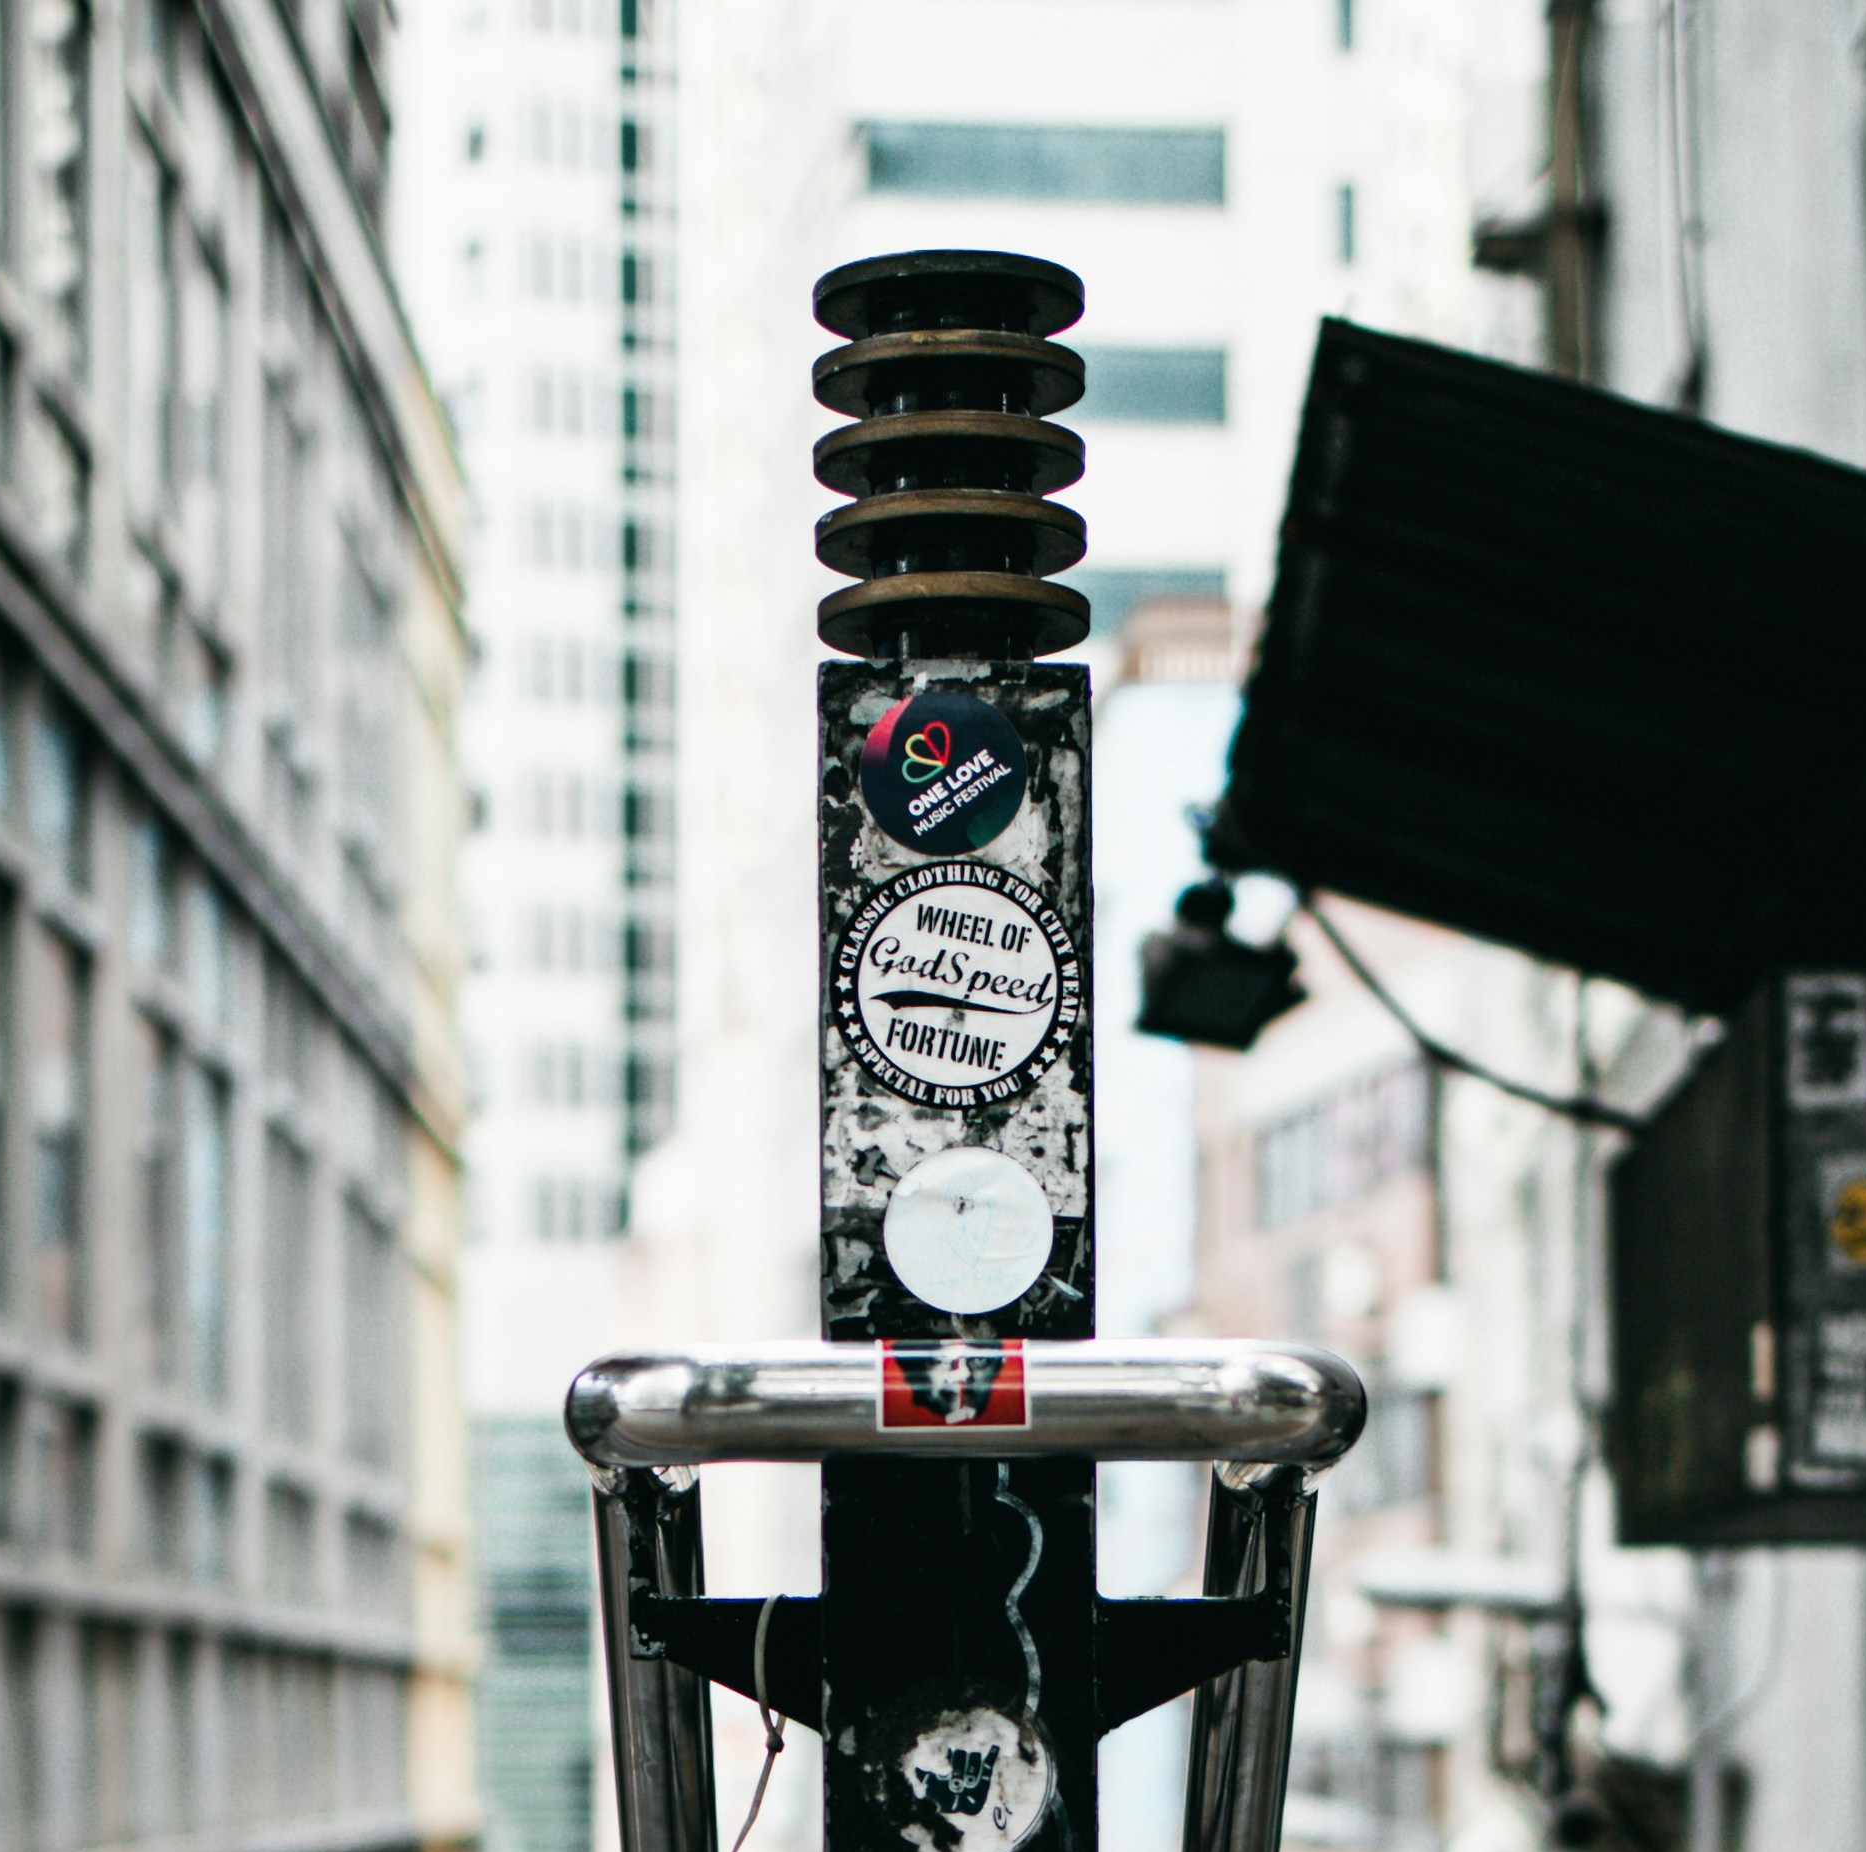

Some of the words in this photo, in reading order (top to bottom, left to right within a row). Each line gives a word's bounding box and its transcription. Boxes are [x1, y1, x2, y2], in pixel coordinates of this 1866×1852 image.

[908, 781, 949, 816] ONE
[945, 748, 995, 791] LOVE
[912, 801, 955, 837] MUSIC
[952, 763, 1012, 808] FESTIVAL
[838, 889, 896, 970] CLASSIC
[893, 863, 1002, 898] CLOTHING
[1001, 878, 1044, 914] FOR
[1038, 908, 1076, 956] CITY
[1057, 958, 1081, 1024] WEAR
[916, 902, 995, 949] WHEEL
[1000, 922, 1034, 954] OF
[853, 1037, 929, 1101] SPECIAL
[932, 1085, 977, 1107] FOR
[978, 1072, 1023, 1105] YOU
[885, 1016, 1008, 1072] FORTUNE
